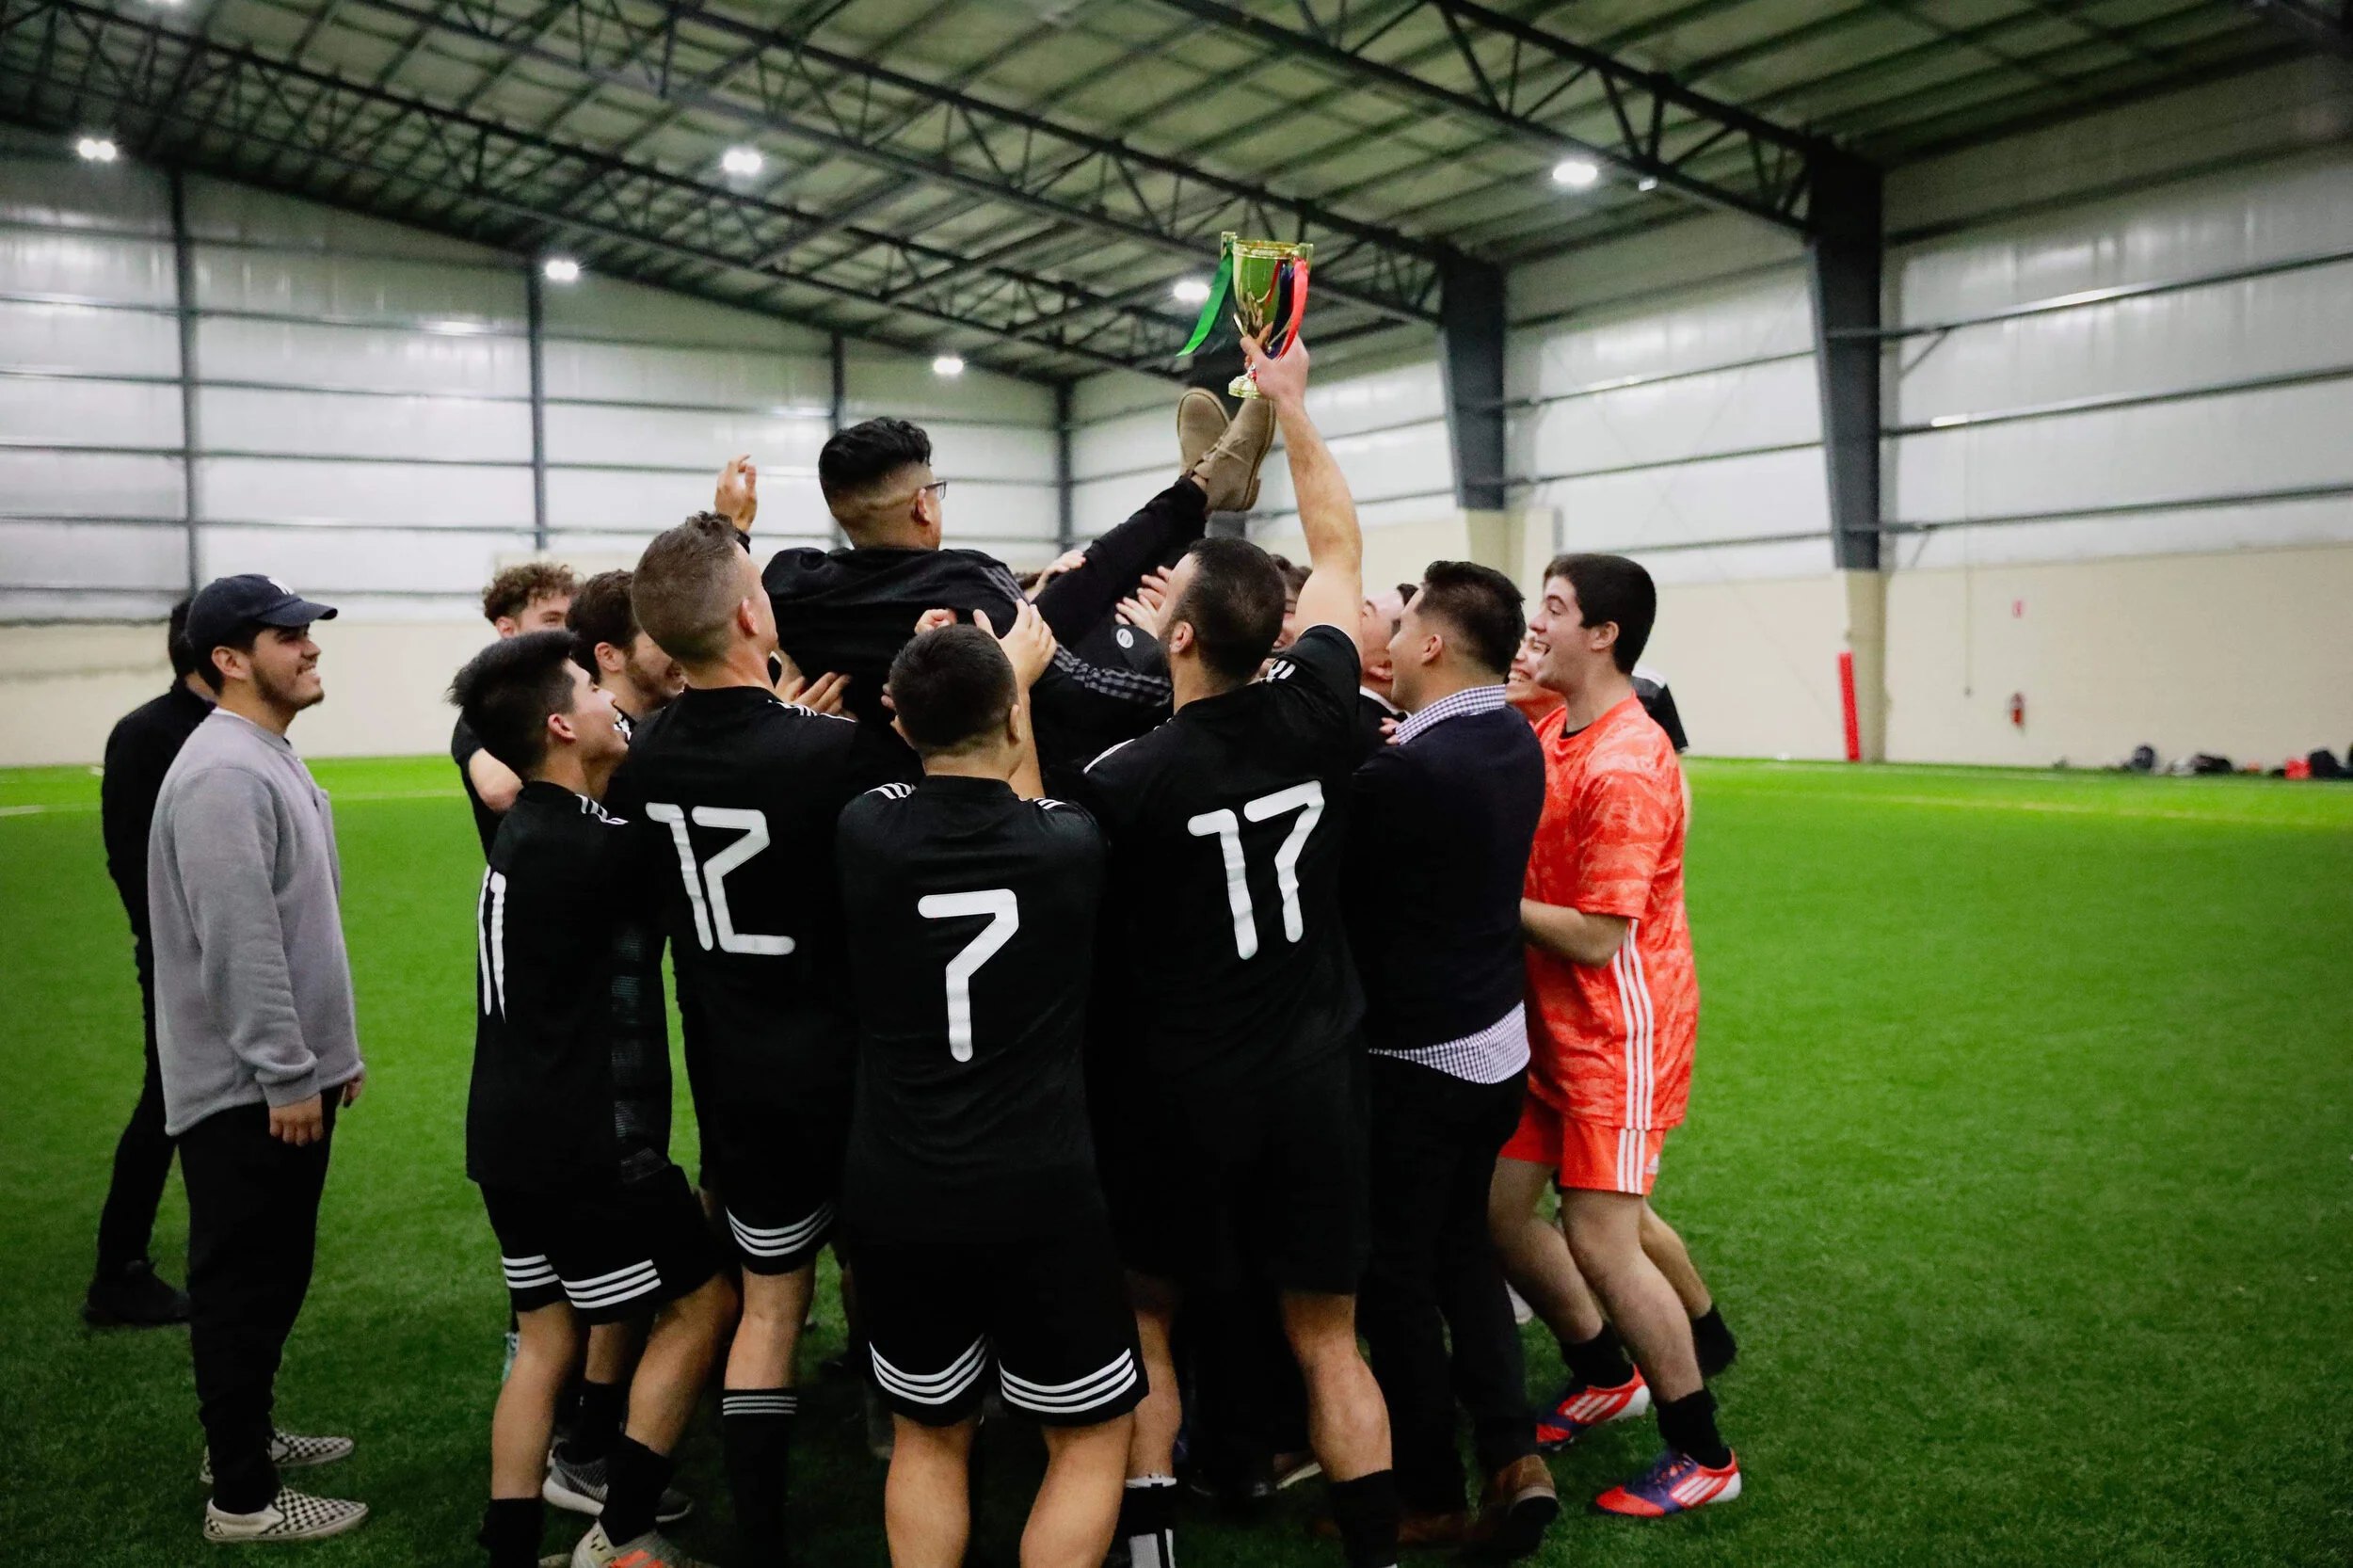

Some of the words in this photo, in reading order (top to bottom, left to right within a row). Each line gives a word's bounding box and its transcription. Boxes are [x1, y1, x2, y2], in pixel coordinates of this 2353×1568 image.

[646, 802, 794, 955] 12
[1187, 780, 1325, 960] 17
[917, 888, 1019, 1062] 7
